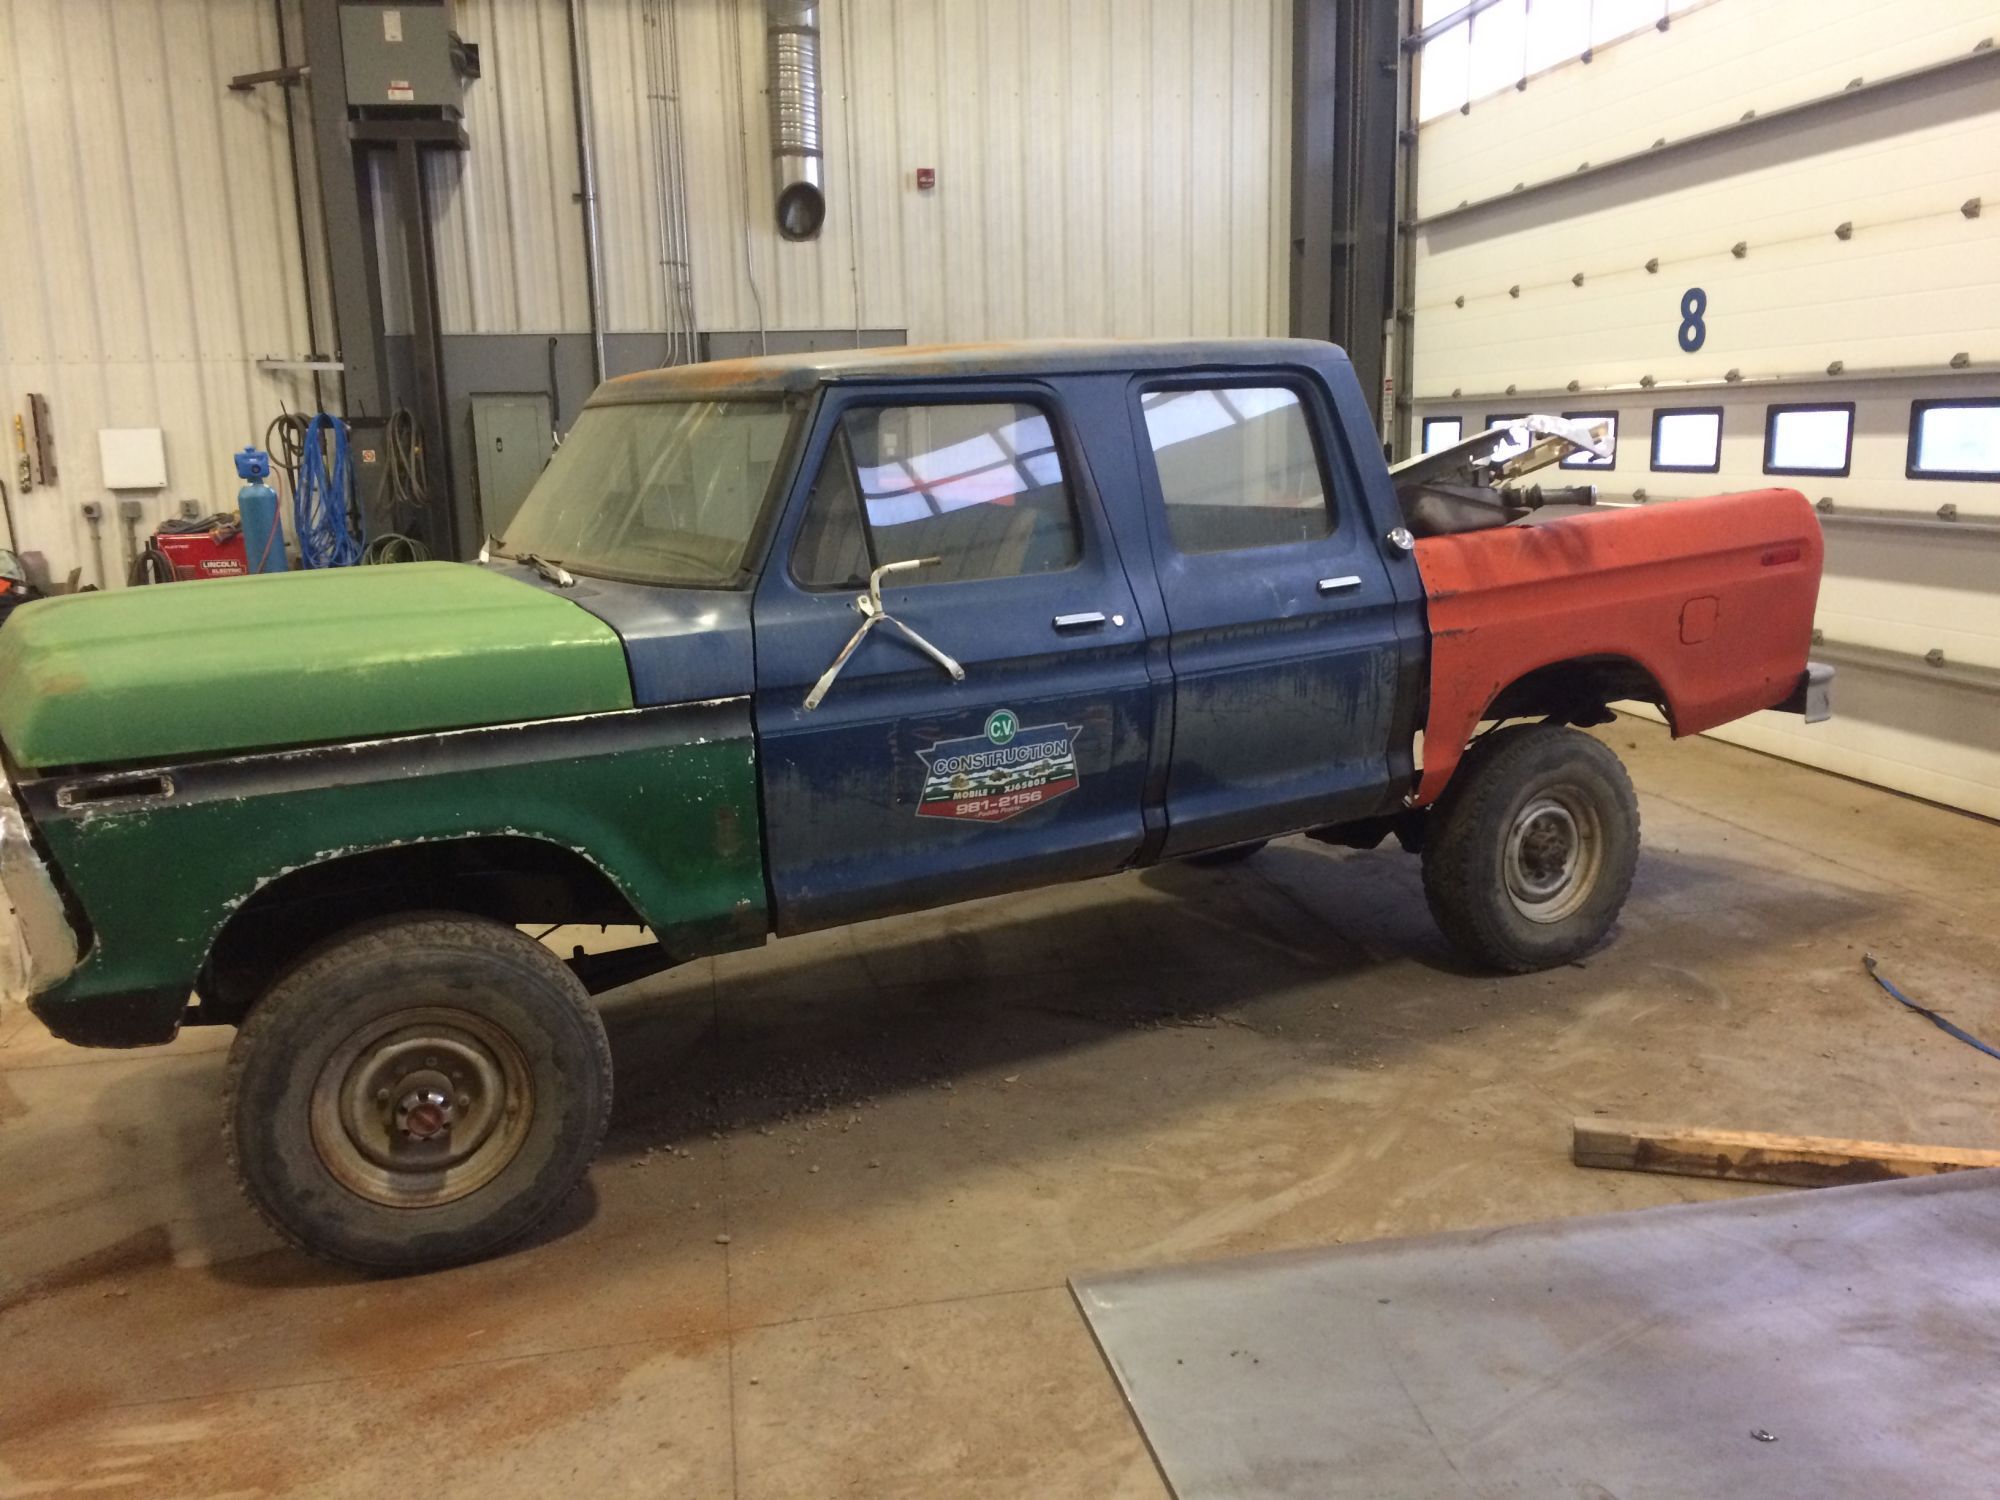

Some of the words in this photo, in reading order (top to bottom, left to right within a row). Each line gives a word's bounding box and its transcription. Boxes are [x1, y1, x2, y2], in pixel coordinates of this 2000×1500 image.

[1678, 287, 1707, 353] 8
[990, 719, 1013, 738] C.V.
[933, 739, 1068, 775] CONSTRUCTION
[952, 788, 988, 800] MOBILE
[955, 790, 1043, 815] 981-2156
